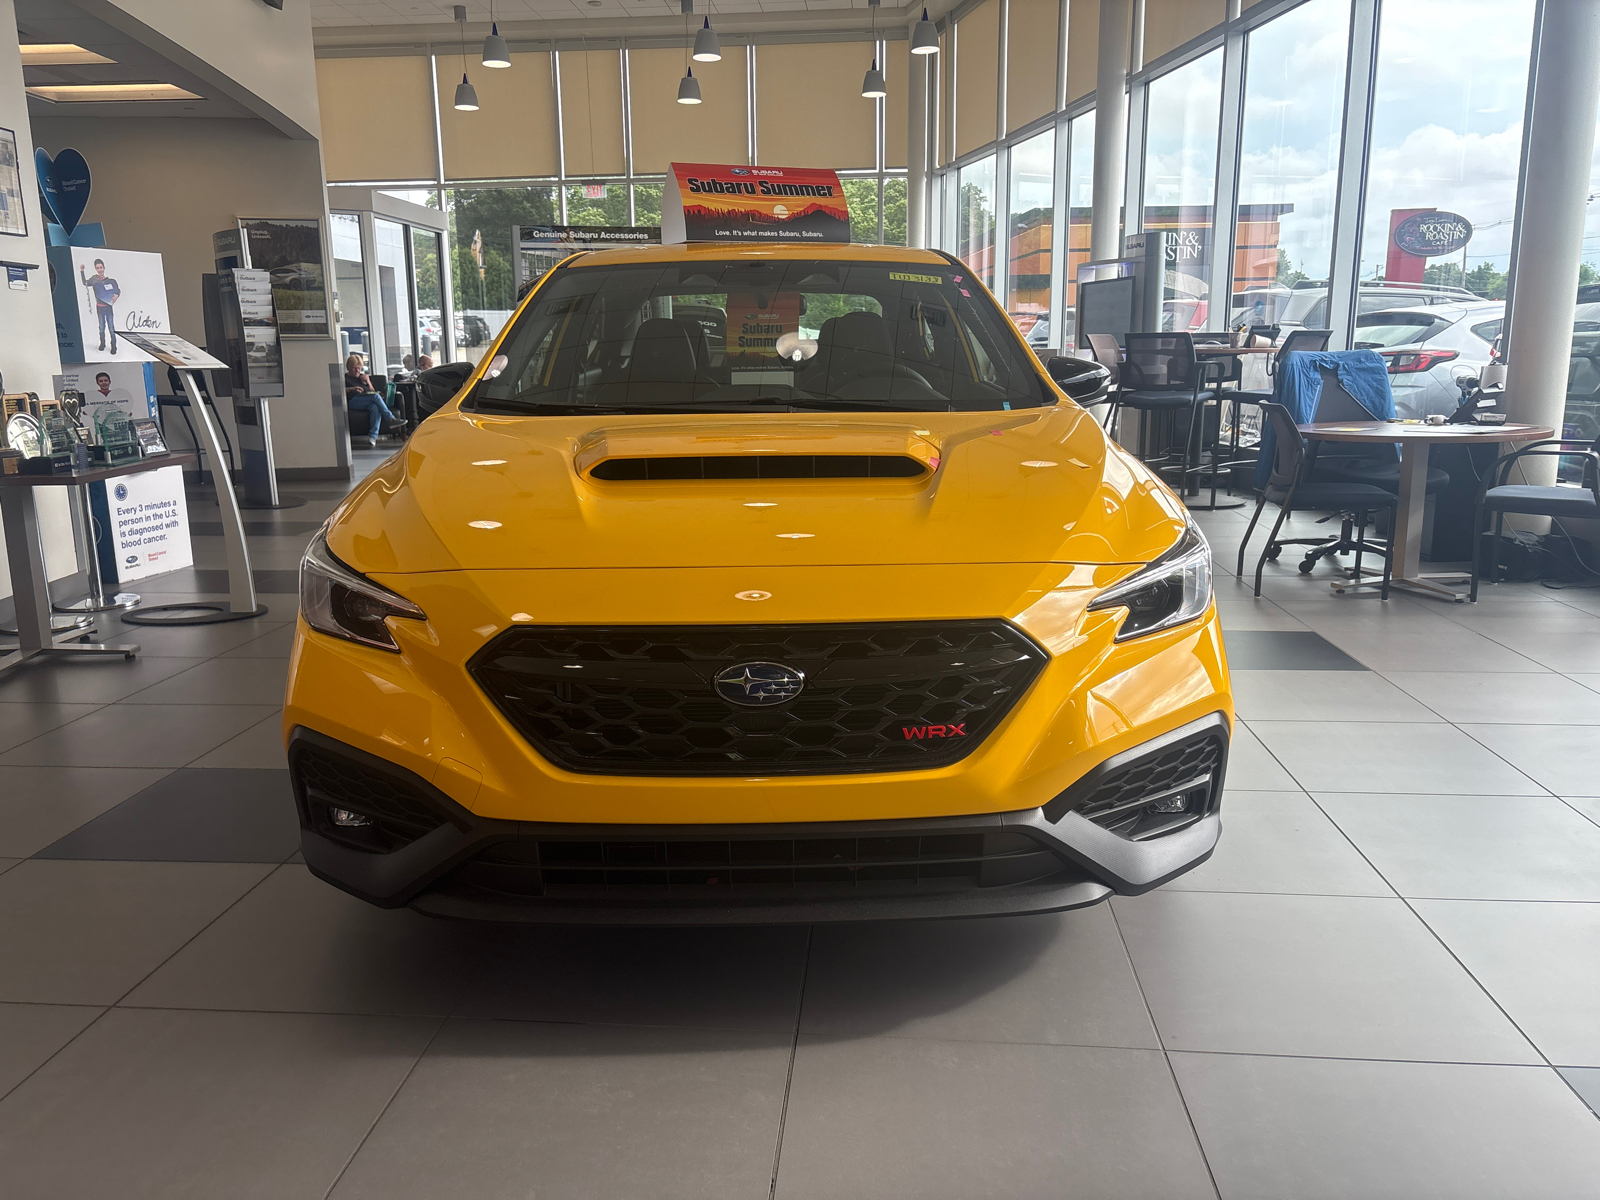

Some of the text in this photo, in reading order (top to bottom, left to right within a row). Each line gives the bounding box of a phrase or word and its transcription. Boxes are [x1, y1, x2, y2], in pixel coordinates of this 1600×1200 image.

[586, 185, 603, 197] EXIT
[686, 177, 835, 198] Subaru Summer
[569, 231, 598, 239] Subaru
[600, 231, 649, 240] Accessories
[715, 229, 732, 237] Love.
[779, 230, 801, 238] Subaru,
[1186, 231, 1200, 246] &
[742, 323, 783, 334] Subaru
[117, 506, 137, 516] Every
[138, 504, 143, 512] 3
[144, 501, 172, 511] minutes
[119, 509, 179, 528] person in the U.S.
[120, 520, 179, 538] is diagnosed with
[121, 534, 168, 549] blood cancer.
[902, 723, 966, 740] WRX
